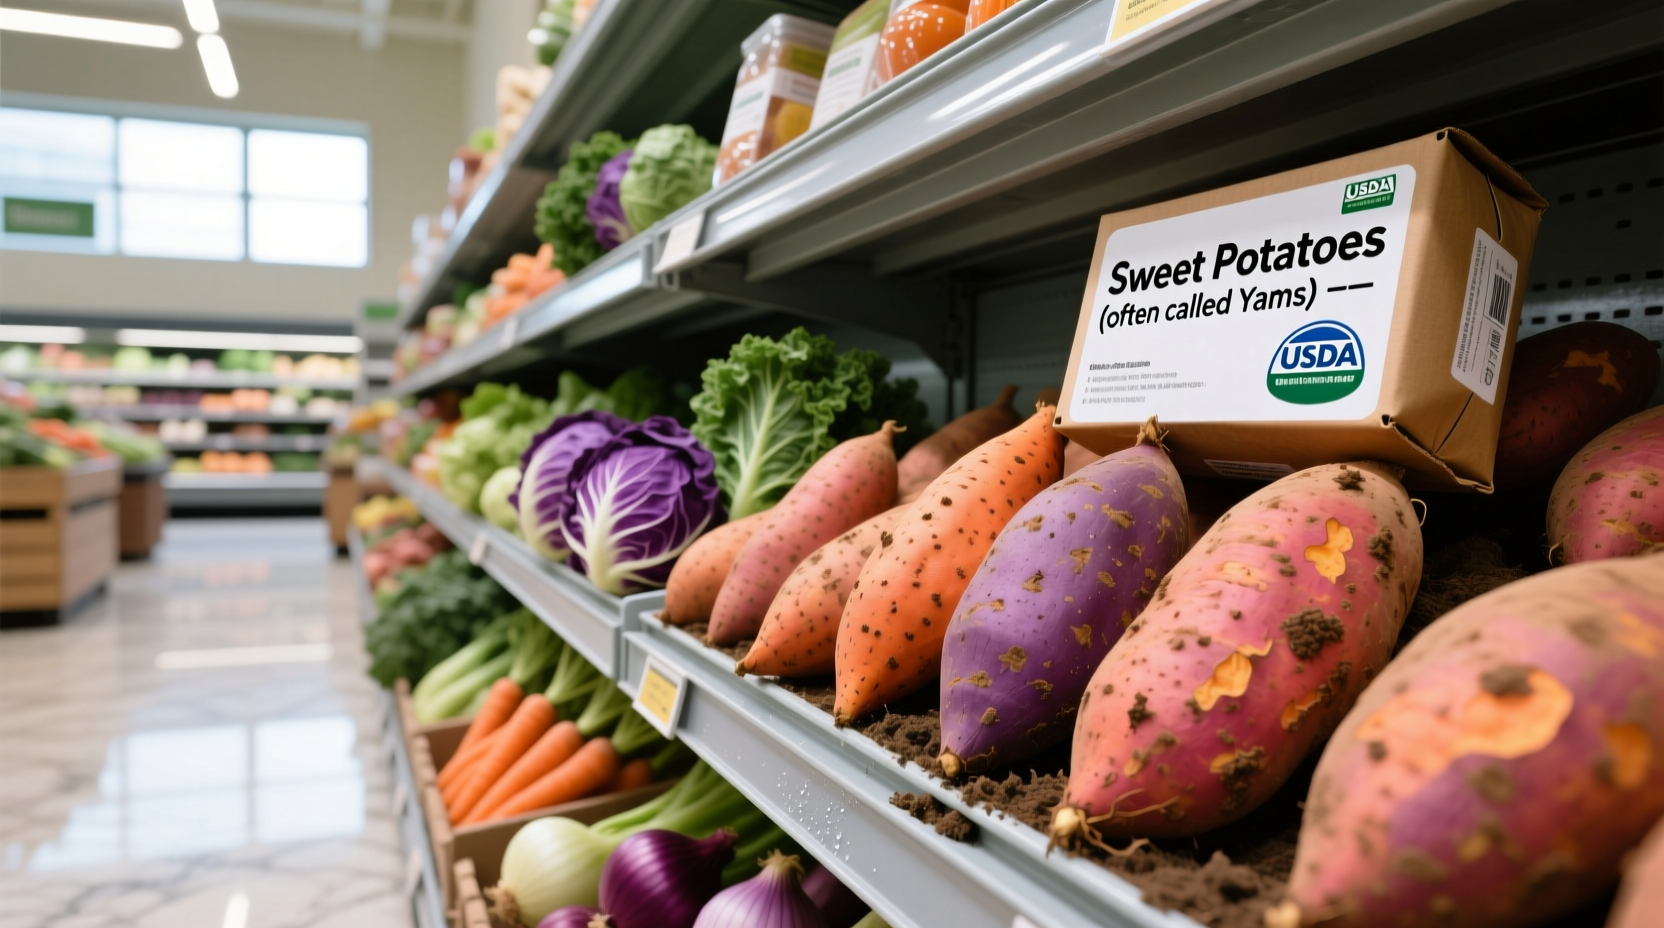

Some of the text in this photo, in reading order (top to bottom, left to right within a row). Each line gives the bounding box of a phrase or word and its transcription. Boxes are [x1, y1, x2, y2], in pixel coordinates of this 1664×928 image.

[1345, 177, 1392, 200] USDA
[1107, 226, 1387, 296] Sweet Potatoes
[1099, 302, 1161, 335] (often
[1164, 289, 1233, 322] called
[1239, 276, 1318, 313] Yams)
[1280, 342, 1358, 370] USDA
